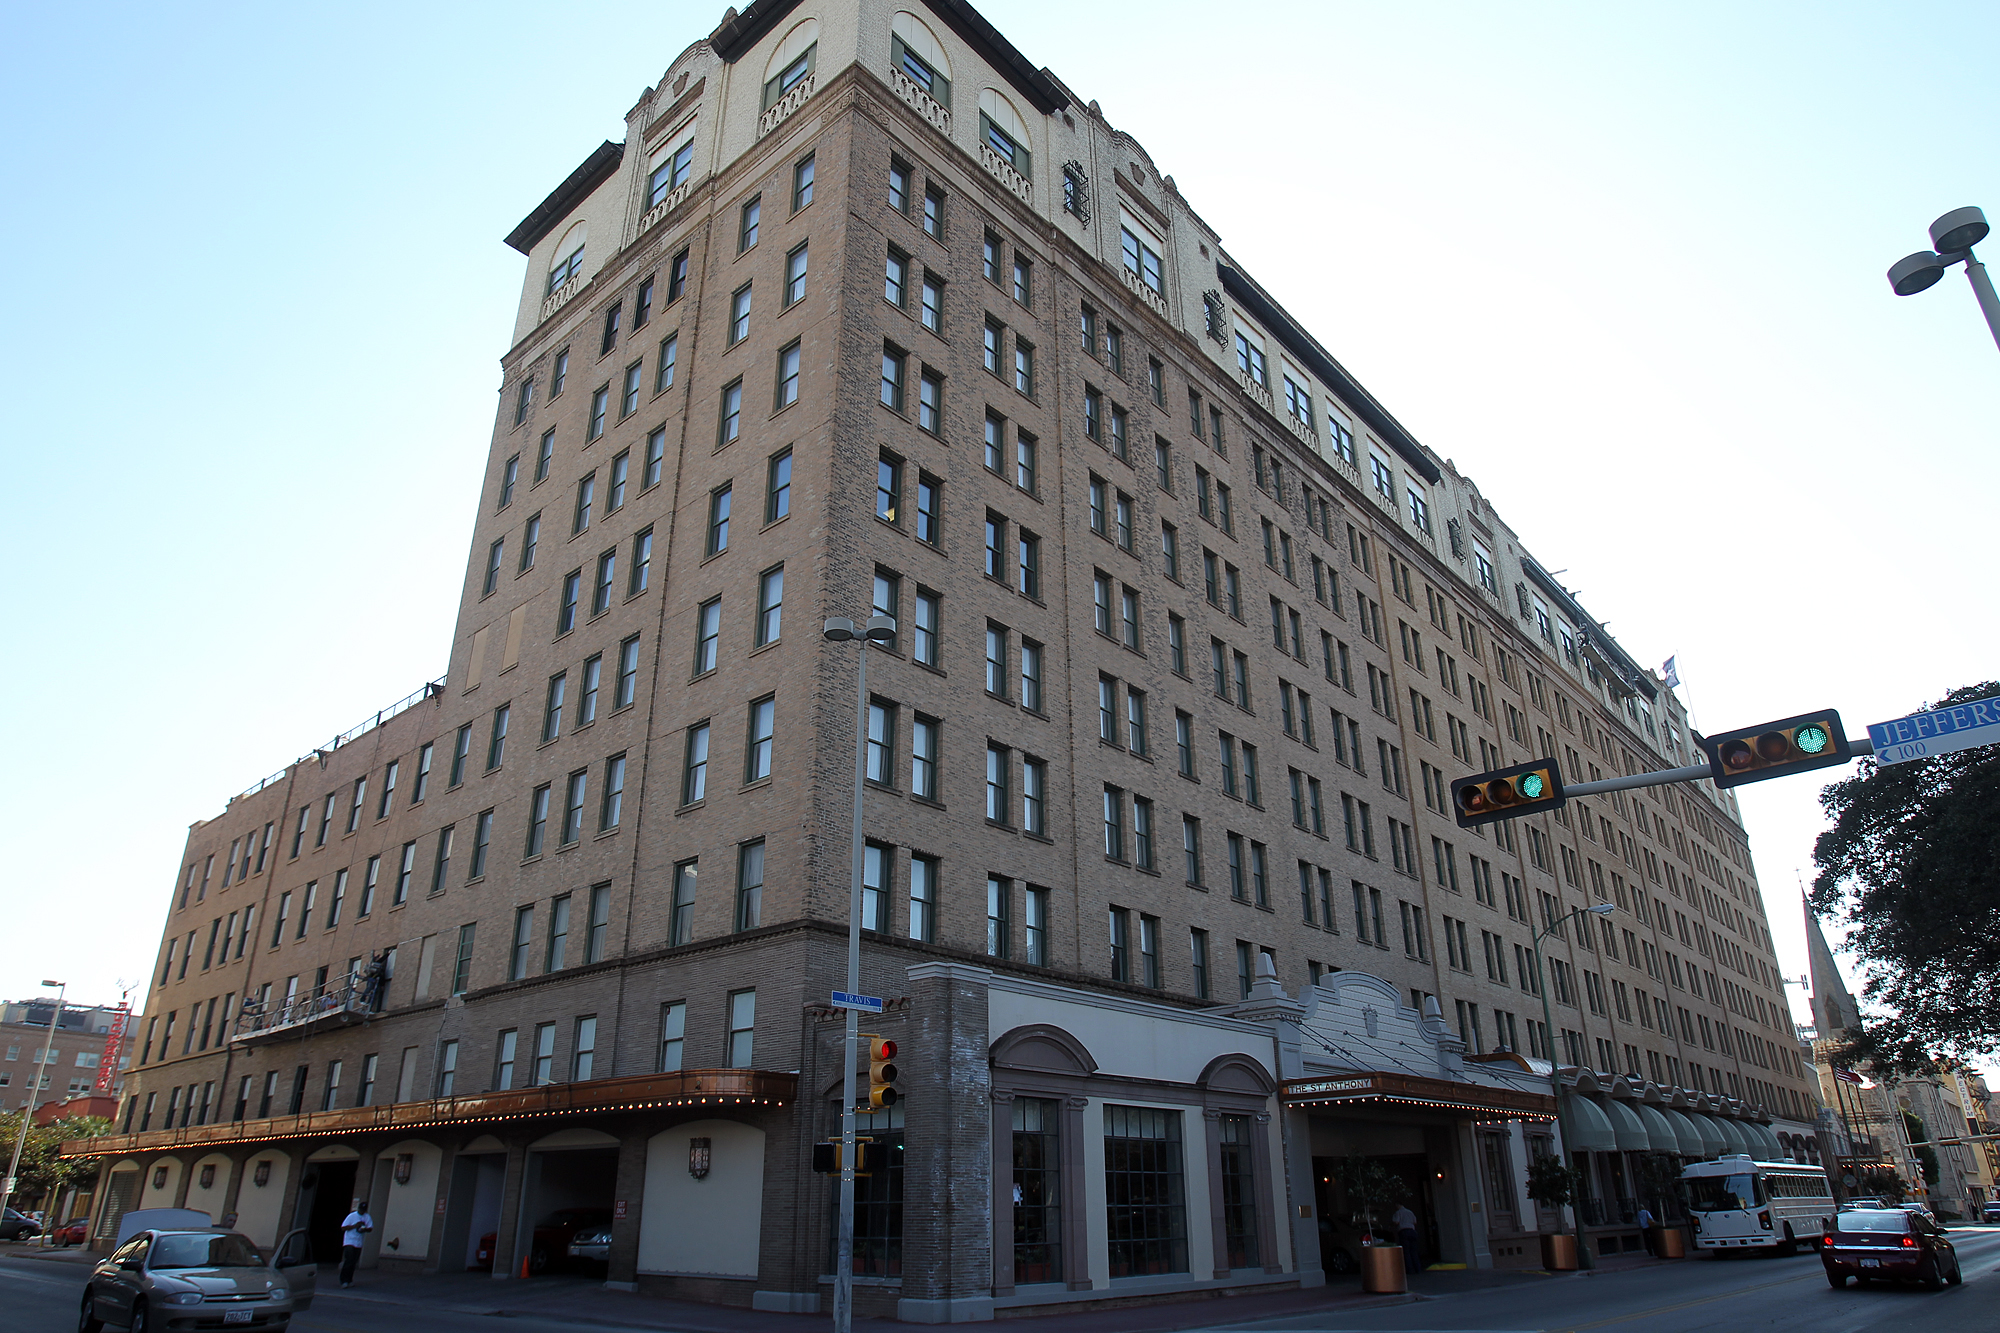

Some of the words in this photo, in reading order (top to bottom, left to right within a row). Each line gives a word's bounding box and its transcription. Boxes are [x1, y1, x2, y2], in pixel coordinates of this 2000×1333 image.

[1897, 742, 1926, 760] 100
[844, 994, 871, 1005] TRAVIS
[1289, 1084, 1307, 1093] THE
[1310, 1083, 1323, 1092] ST
[1325, 1079, 1370, 1091] ANTHONY
